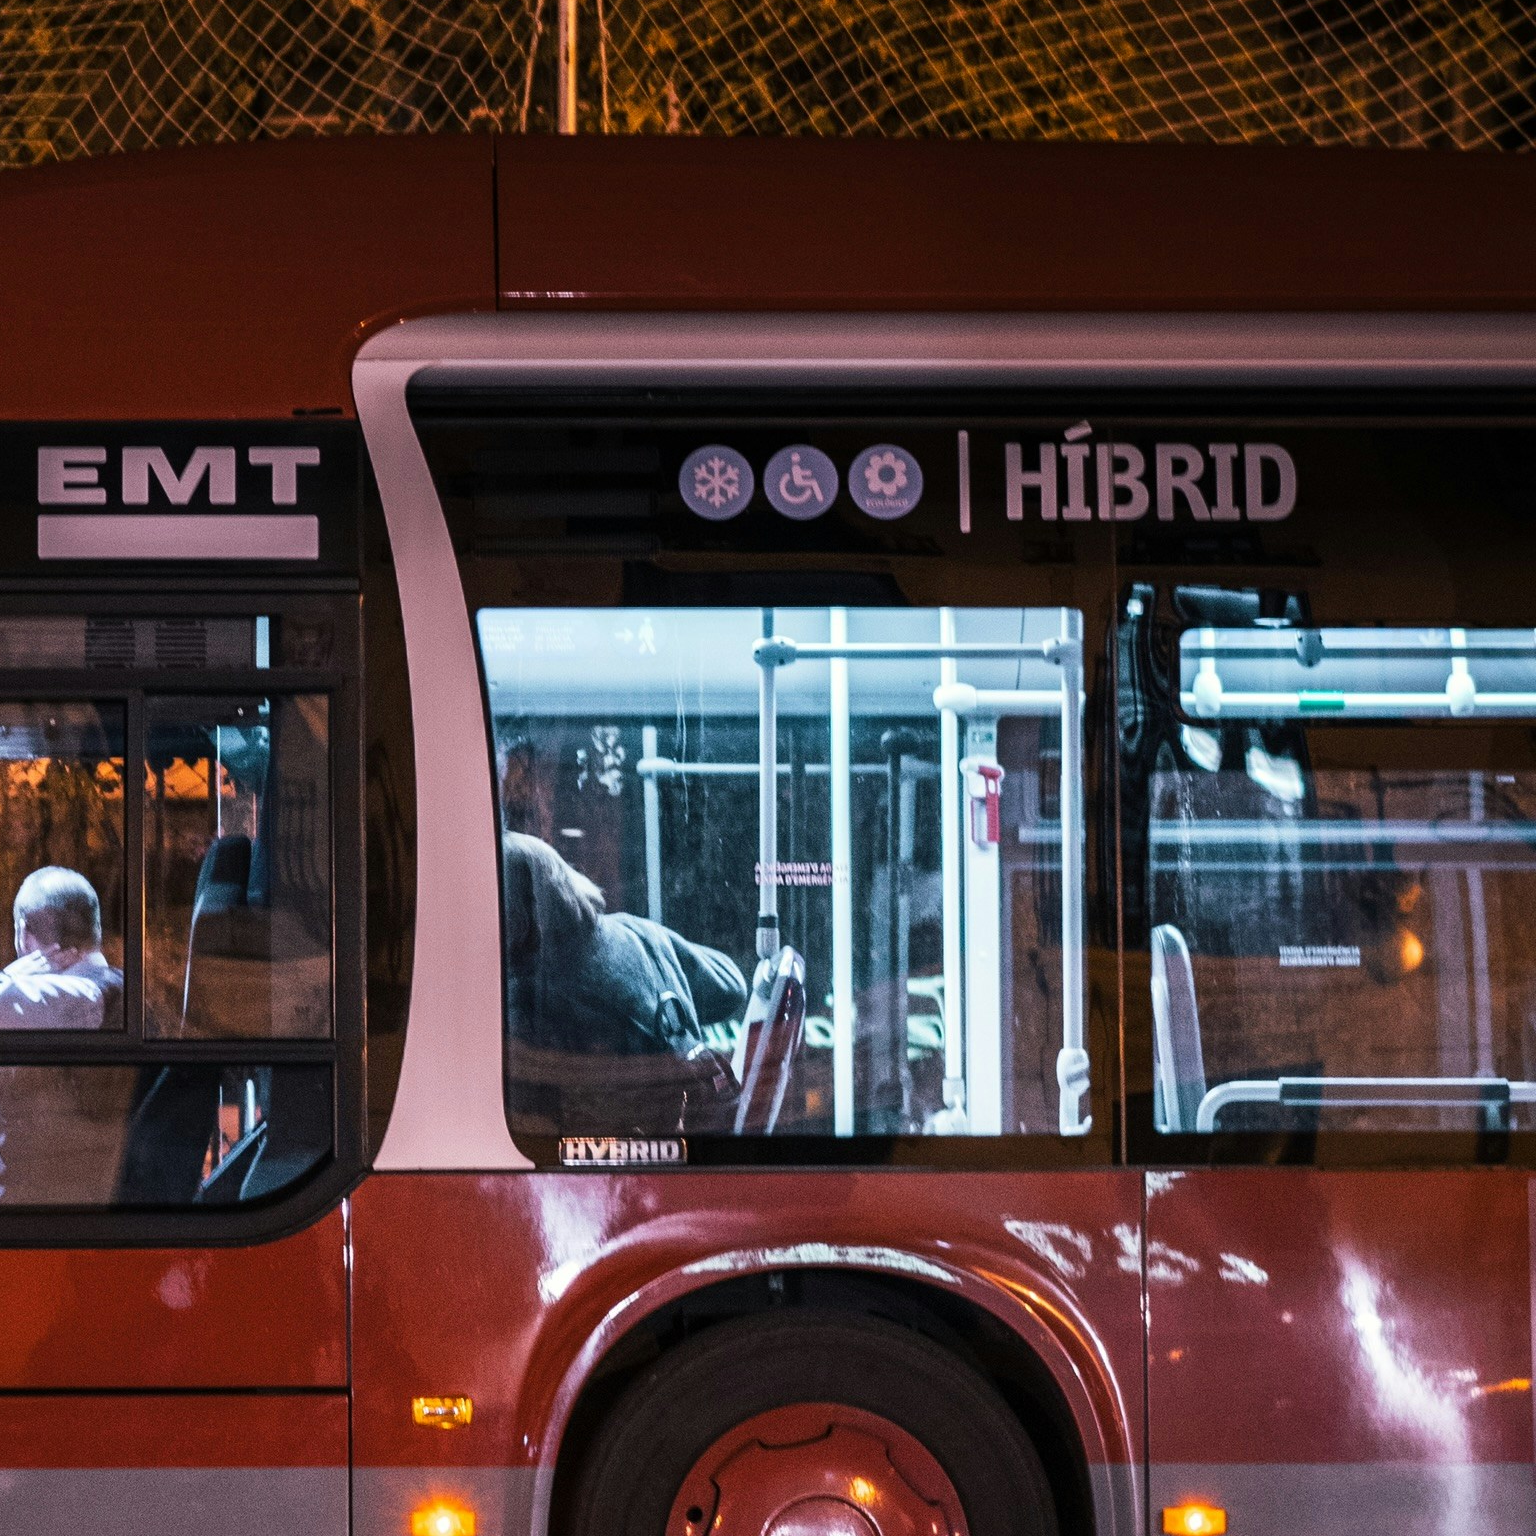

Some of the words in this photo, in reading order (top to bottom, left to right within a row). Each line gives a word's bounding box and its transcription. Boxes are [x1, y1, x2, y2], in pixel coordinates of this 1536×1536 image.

[38, 446, 320, 505] EMT
[1005, 420, 1296, 521] HÍBRID
[566, 1138, 680, 1161] HYBRID
